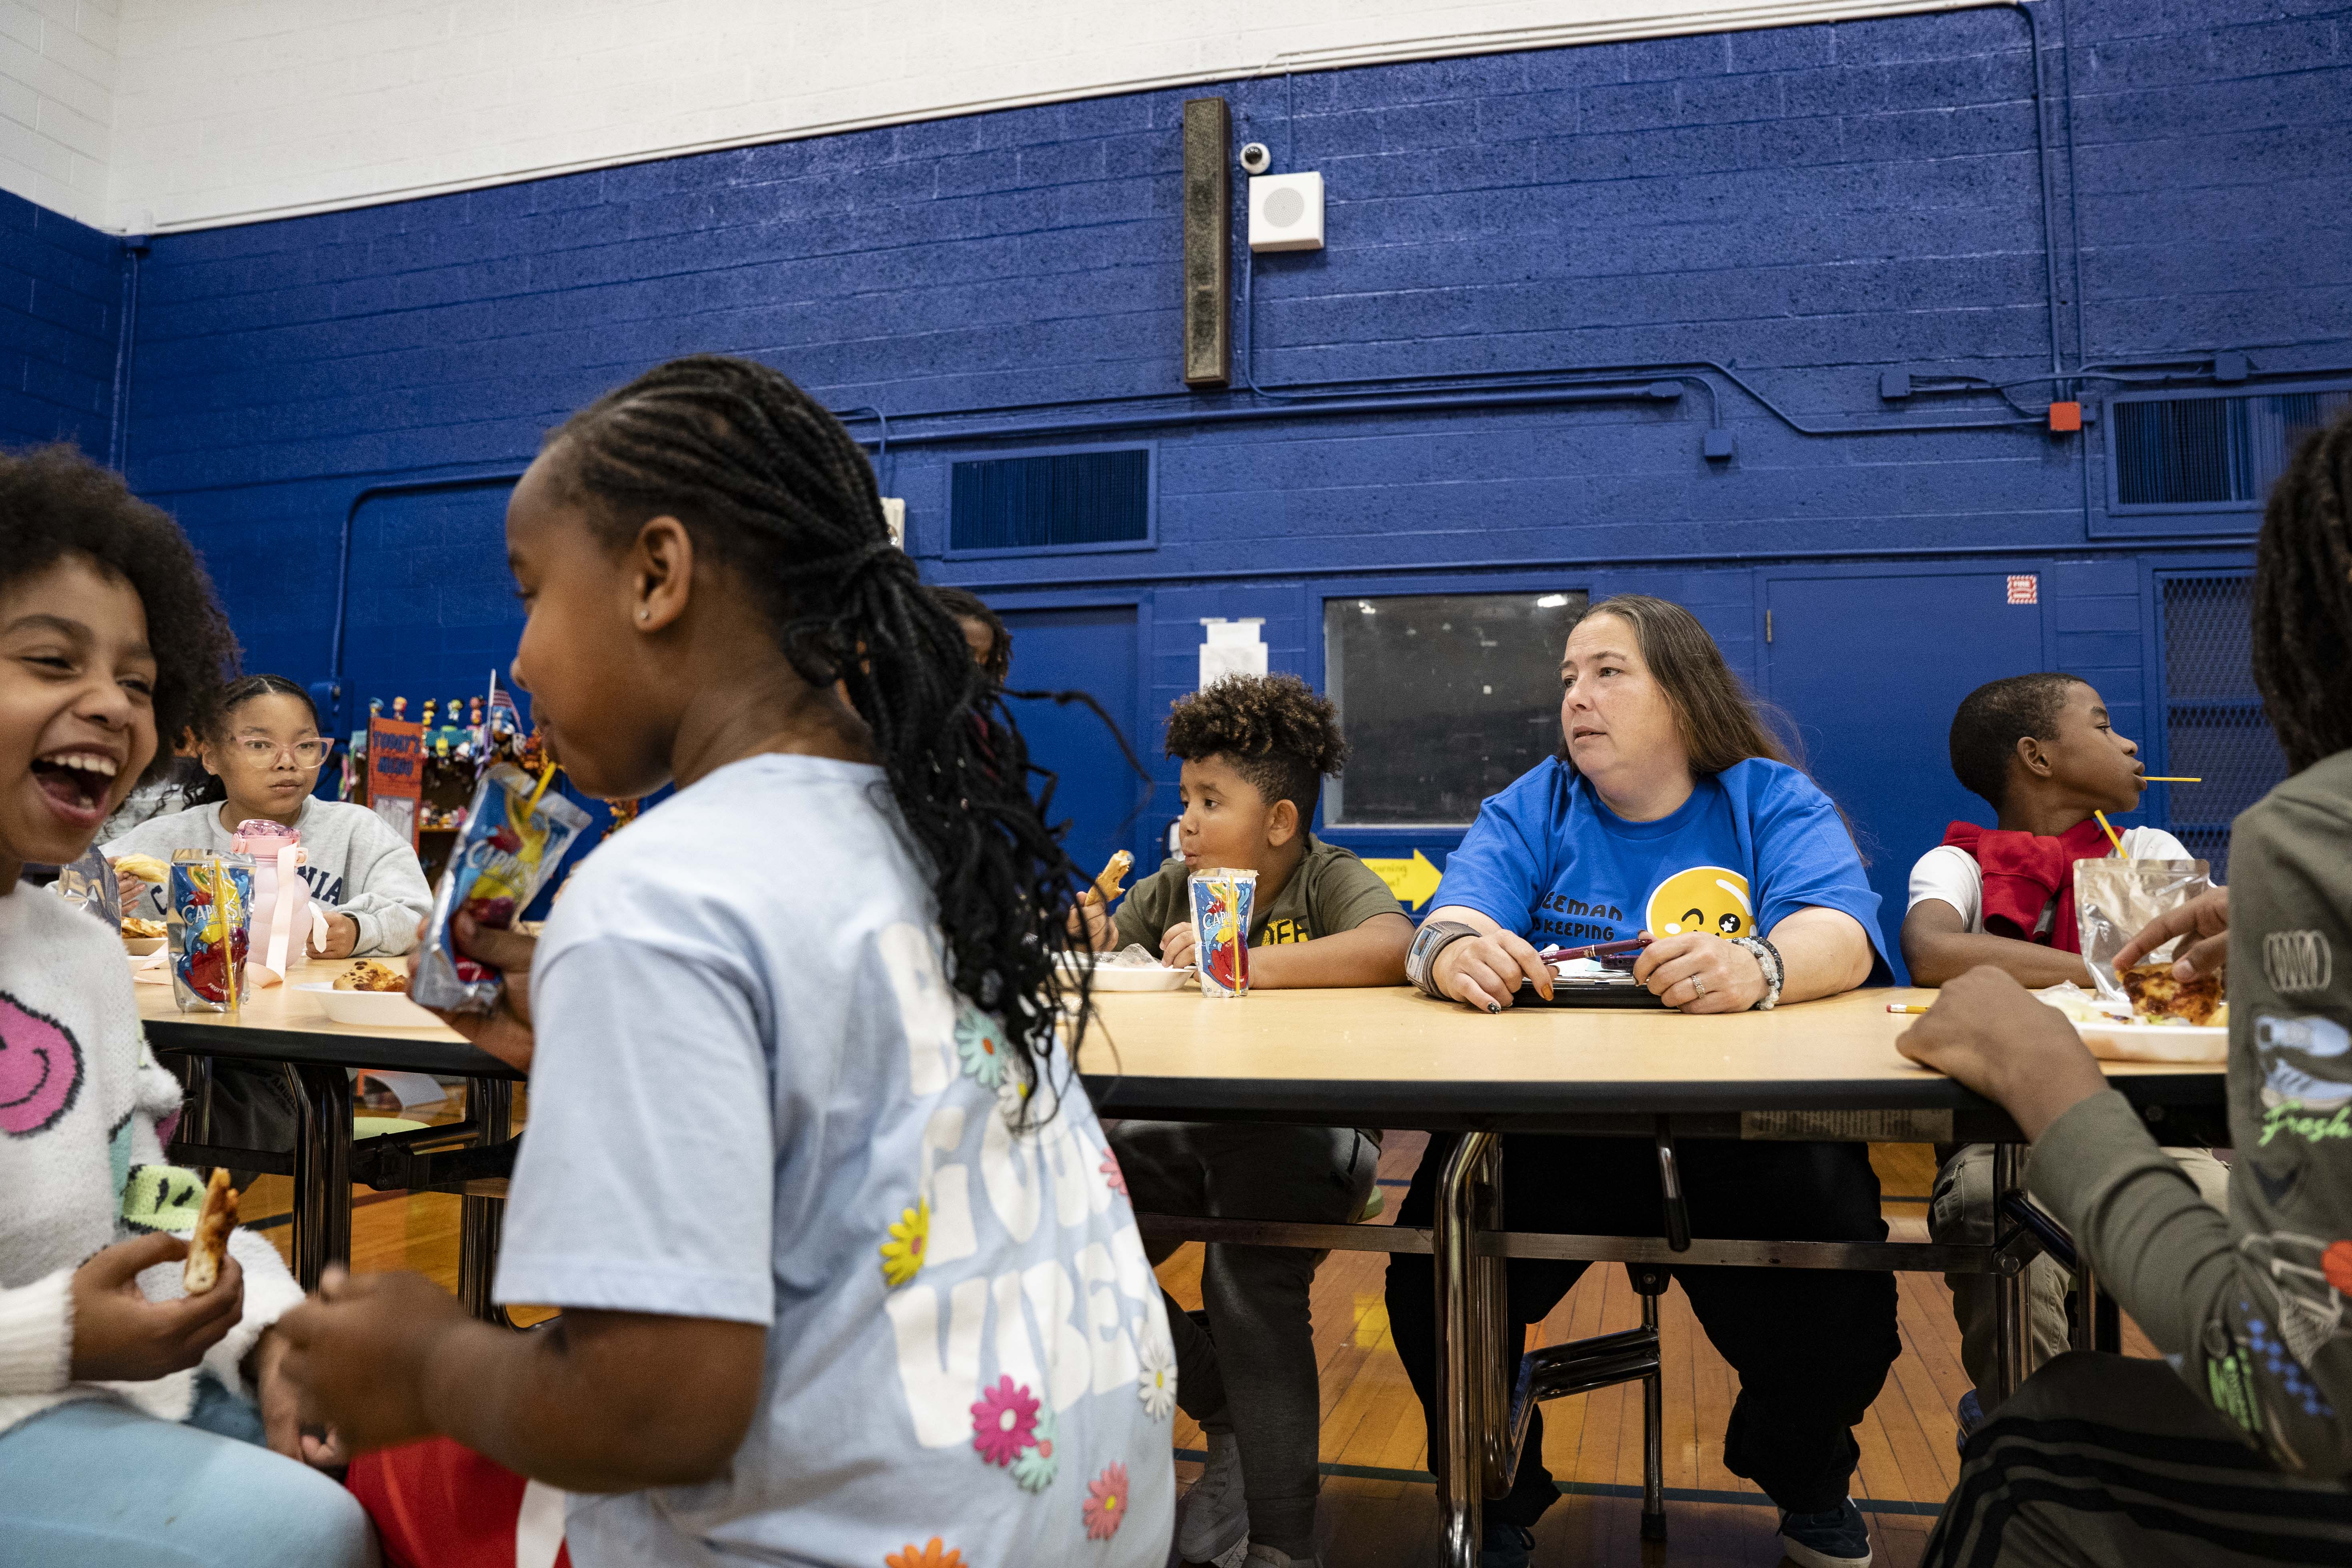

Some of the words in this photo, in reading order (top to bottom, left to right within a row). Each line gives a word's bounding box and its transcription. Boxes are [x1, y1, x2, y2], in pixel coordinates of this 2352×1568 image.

[182, 905, 219, 927] CAPR
[1542, 891, 1622, 922] EEMAN
[1544, 919, 1615, 941] KEEPING
[1225, 974, 1235, 982] FRUIT
